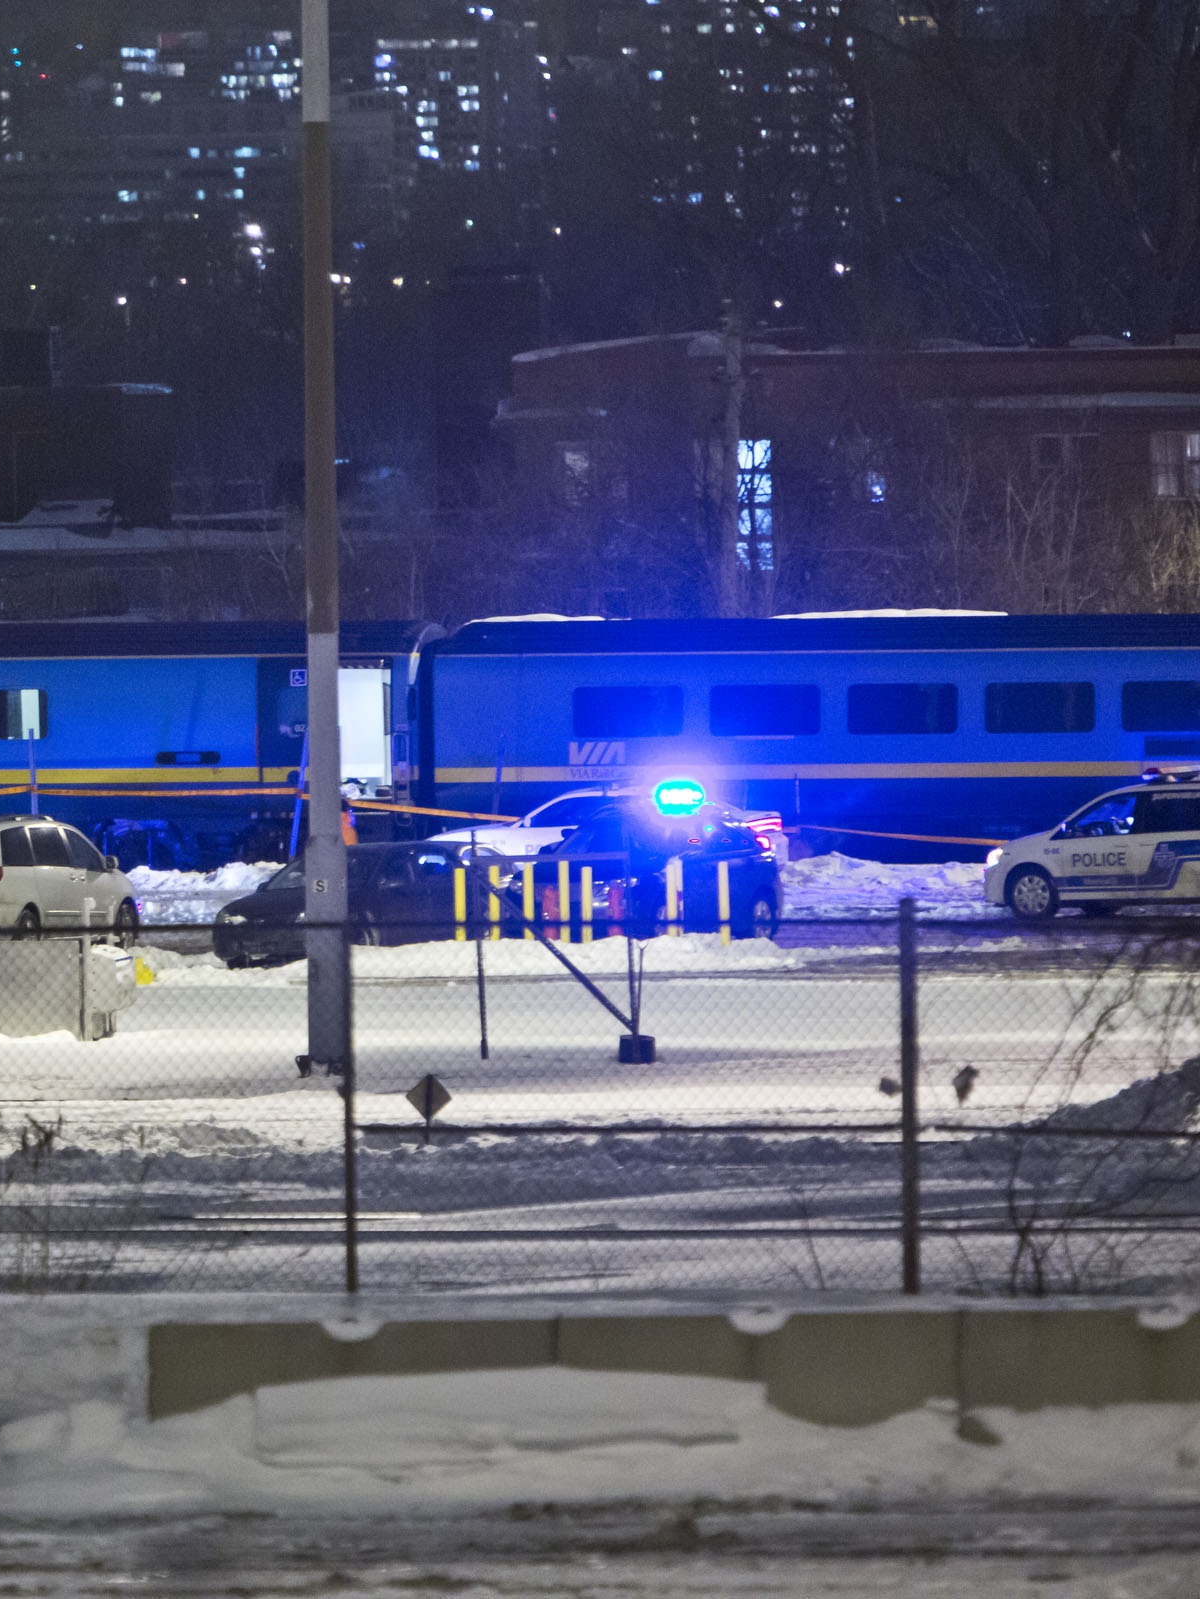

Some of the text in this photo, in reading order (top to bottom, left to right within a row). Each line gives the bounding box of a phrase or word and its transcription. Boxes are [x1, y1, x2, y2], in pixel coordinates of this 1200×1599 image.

[569, 741, 626, 765] VIA
[1071, 852, 1128, 868] POLICE
[315, 879, 326, 893] S
